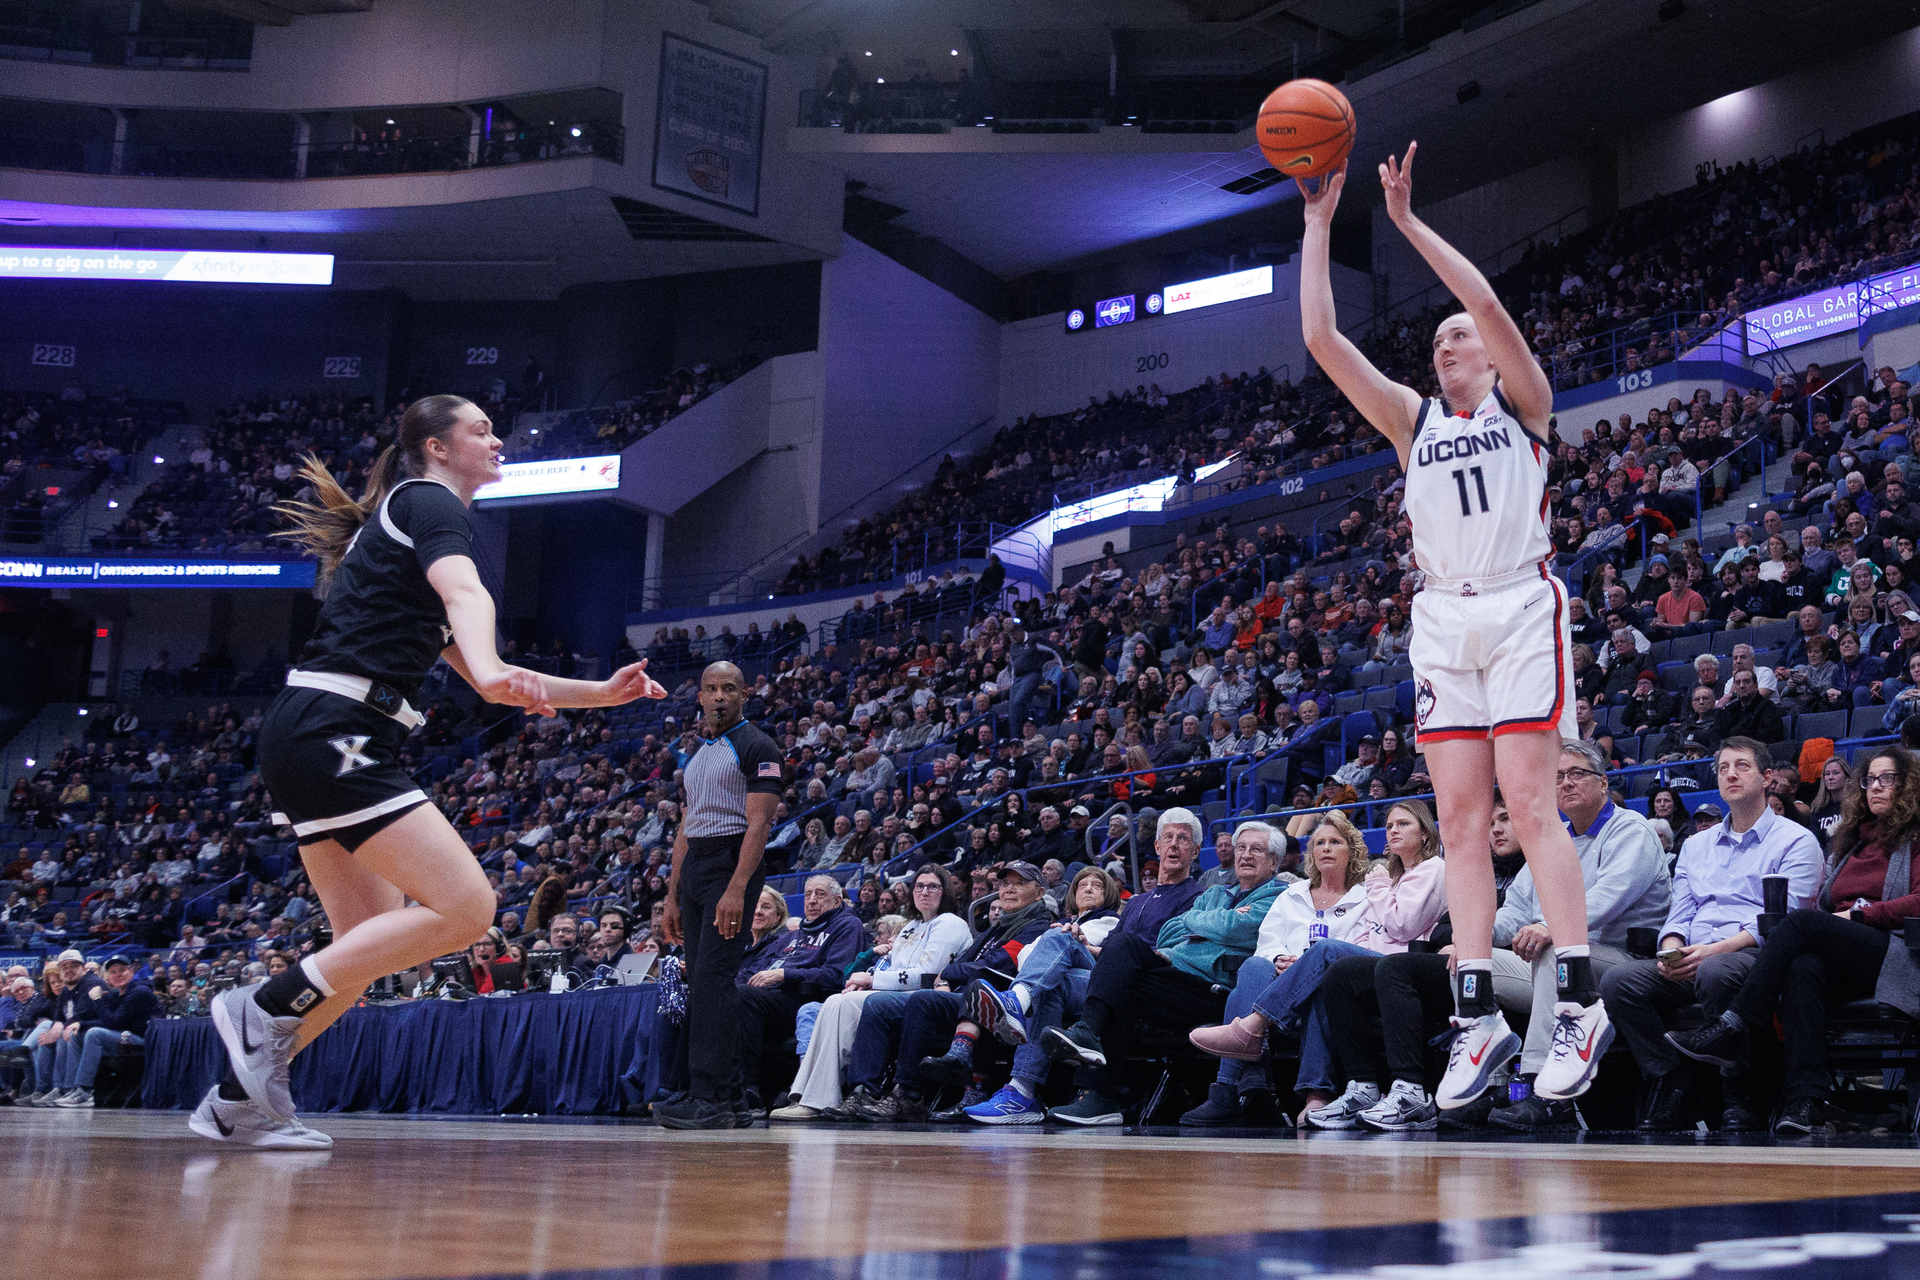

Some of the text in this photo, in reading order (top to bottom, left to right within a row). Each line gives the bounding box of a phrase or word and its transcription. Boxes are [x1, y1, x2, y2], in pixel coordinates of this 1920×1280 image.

[22, 255, 39, 269] to
[41, 257, 51, 269] a
[55, 255, 81, 273] gig
[83, 258, 105, 270] on
[106, 255, 130, 270] the
[136, 258, 158, 275] go
[191, 257, 246, 274] xfinity
[1171, 292, 1191, 302] LAZ
[1750, 304, 1816, 334] GLOBAL
[35, 346, 74, 366] 228
[467, 348, 498, 365] 229
[1137, 352, 1169, 373] 200
[327, 359, 359, 376] 229
[1617, 369, 1653, 393] 103
[1418, 428, 1511, 467] UCONN
[1281, 477, 1304, 496] 102
[1452, 465, 1490, 517] 11
[46, 566, 93, 575] HEALTH
[99, 565, 176, 575] ORTHOPEDICS
[185, 565, 228, 575] SPORTS
[228, 565, 281, 575] MEDICINE
[904, 569, 922, 584] 101
